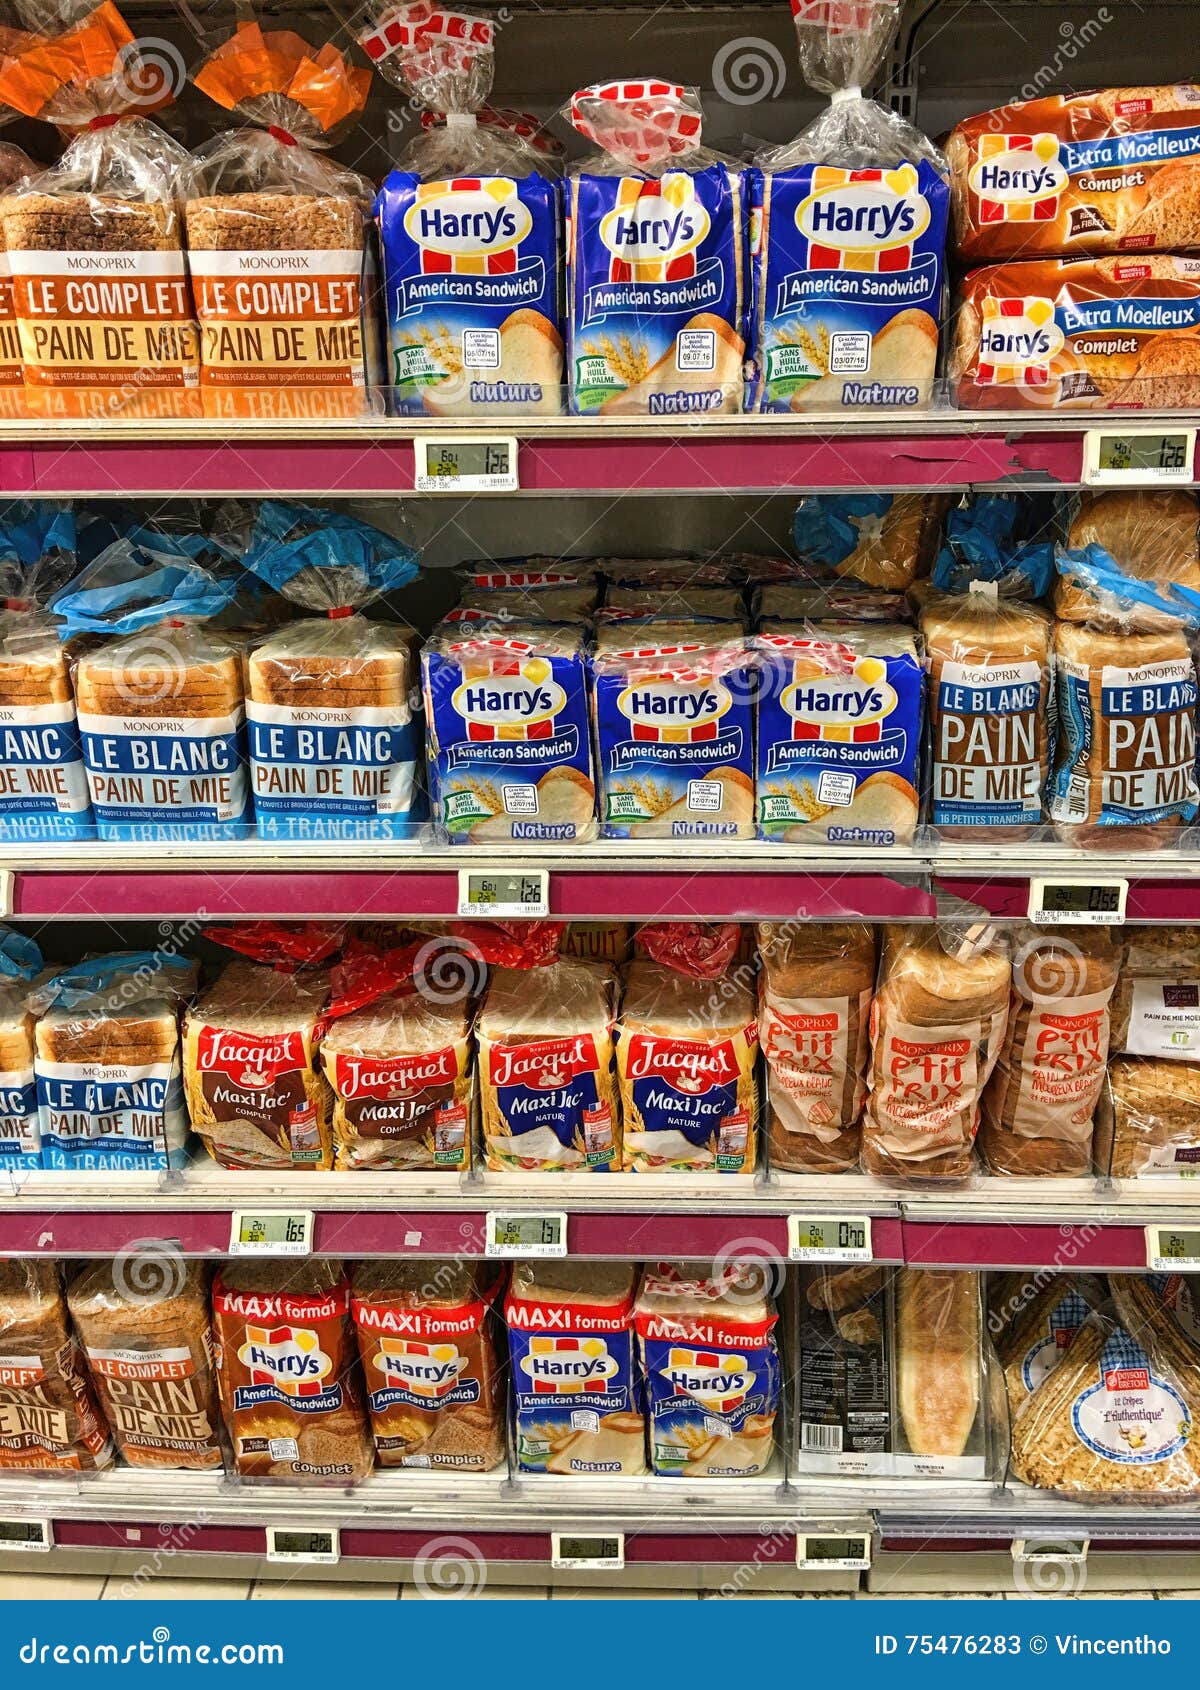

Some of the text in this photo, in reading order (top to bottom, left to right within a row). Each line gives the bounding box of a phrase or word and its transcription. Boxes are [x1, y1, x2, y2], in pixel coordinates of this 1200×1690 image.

[1067, 136, 1200, 169] Extra Moelleux
[981, 165, 1057, 194] Harrys
[1078, 172, 1145, 193] Complet
[420, 206, 516, 244] Harrys
[615, 211, 694, 250] Harrys
[813, 199, 915, 239] Harrys
[67, 256, 137, 270] MONOPRIX
[239, 256, 310, 270] MONOPRIX
[27, 280, 58, 314] LE
[66, 281, 186, 315] COMPLET
[408, 276, 539, 300] American Sandwich
[594, 280, 717, 307] American Sandwich
[790, 275, 930, 297] American Sandwich
[202, 281, 356, 315] LE COMPLET
[1064, 303, 1195, 329] Extra Moelleux
[34, 326, 95, 361] PAIN
[104, 327, 138, 361] DE
[145, 327, 195, 361] MIE
[272, 326, 362, 361] DE MIE
[405, 350, 426, 358] SANS
[779, 349, 800, 358] SANS
[1073, 338, 1138, 356] Complet
[402, 363, 436, 376] DE PALME
[406, 356, 428, 366] HUILE
[586, 360, 606, 368] SANS
[774, 364, 809, 376] DE PALME
[779, 356, 801, 365] HUILE
[834, 356, 866, 364] 03/07/16
[587, 368, 608, 376] HUILE
[592, 375, 615, 384] PALME
[470, 381, 542, 402] Nature
[649, 389, 723, 415] Nature
[842, 383, 919, 406] Nature
[1127, 666, 1187, 683] MONOPRIX
[466, 687, 553, 716] Harrys
[631, 689, 719, 720] Harrys
[795, 687, 883, 718] Harrys
[944, 686, 1036, 713] LE BLANC
[1109, 690, 1134, 713] LE
[124, 721, 185, 733] MONOPRIX
[290, 711, 352, 722] MONOPRIX
[255, 727, 392, 763] LE BLANC
[940, 713, 1036, 763] PAIN
[1109, 709, 1197, 770] PAIN
[88, 737, 229, 771] LE BLANC
[457, 741, 573, 760] American Sandwich
[621, 742, 737, 761] American Sandwich
[778, 745, 899, 763] American Sandwich
[26, 768, 69, 794] MIE
[92, 775, 233, 805] PAIN DE MIE
[256, 766, 392, 797] PAIN DE MIE
[940, 766, 1035, 801] DE MIE
[1110, 774, 1145, 808] DE
[771, 798, 789, 806] SANS
[777, 811, 798, 819] PALME
[951, 814, 986, 826] PETITES
[987, 811, 1035, 826] TRANCHES
[258, 815, 394, 841] 14 TRANCHES
[511, 820, 577, 841] Nature
[827, 827, 895, 844] Nature
[1144, 1013, 1161, 1021] PAIN
[340, 1054, 450, 1098] Jacquet
[44, 1081, 74, 1108] LE
[213, 1085, 292, 1110] Maxi Jac'
[510, 1091, 557, 1115] Maxi
[645, 1089, 726, 1117] Maxi Jac'
[235, 1107, 273, 1121] COMPLET
[360, 1101, 405, 1121] Maxi
[535, 1112, 566, 1122] NATURE
[667, 1116, 702, 1128] NATURE
[51, 1112, 124, 1137] PAIN DE
[223, 1293, 337, 1319] MAXI format
[507, 1305, 627, 1329] MAXI format
[359, 1307, 477, 1335] MAXI format
[646, 1320, 714, 1343] MAXI
[98, 1360, 187, 1378] LE COMPLET
[250, 1346, 320, 1376] Harrys
[386, 1356, 459, 1382] Harrys
[533, 1358, 608, 1378] Harrys
[671, 1371, 746, 1393] Harrys
[105, 1377, 199, 1414] PAIN
[242, 1388, 340, 1409] American Sandwich
[377, 1389, 476, 1409] American Sandwich
[523, 1395, 624, 1408] American Sandwich
[15, 1405, 61, 1440] MIE
[119, 1406, 206, 1438] DE MIE
[125, 1433, 209, 1450] GRAND FORMAT
[292, 1461, 352, 1475] Complet
[570, 1459, 623, 1472] Nature
